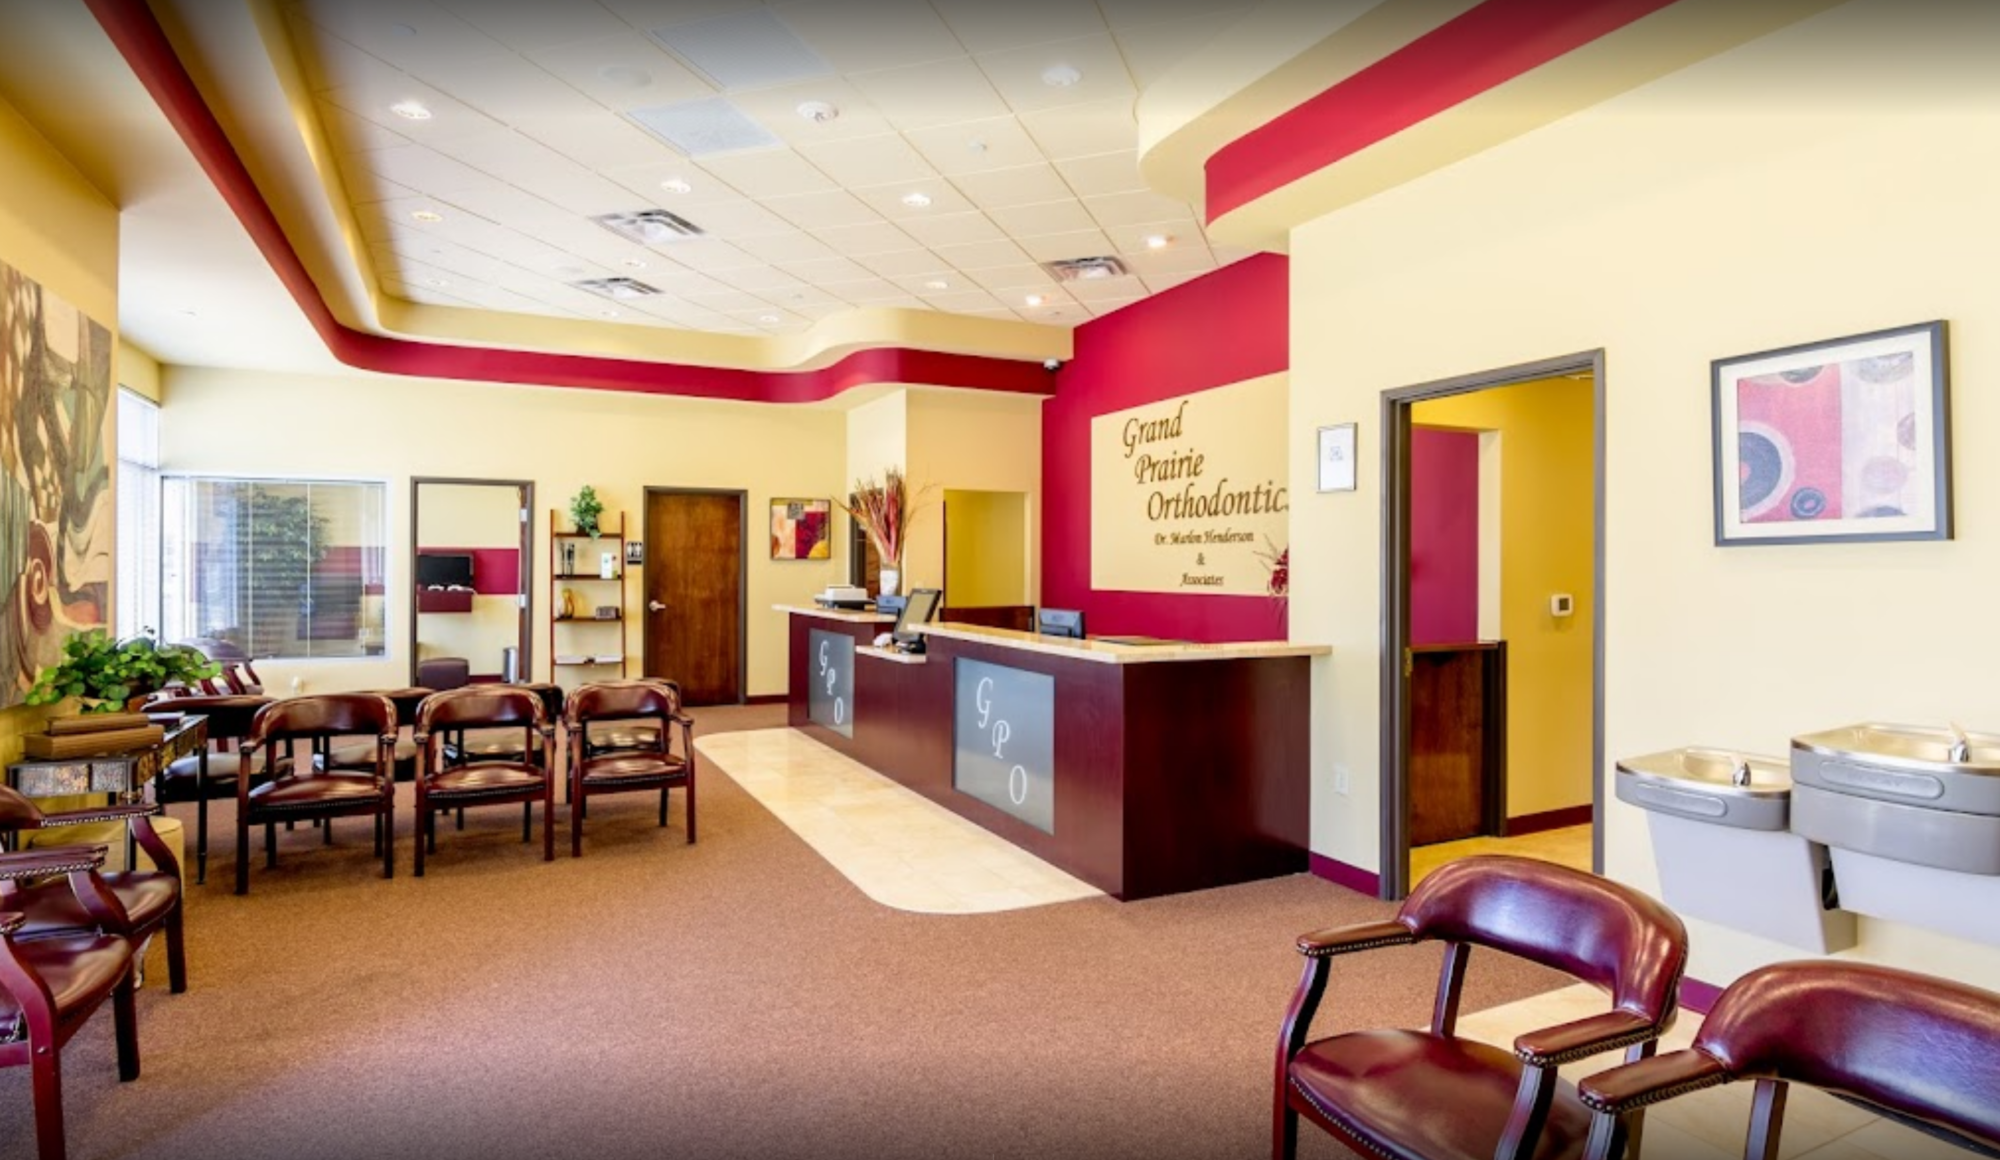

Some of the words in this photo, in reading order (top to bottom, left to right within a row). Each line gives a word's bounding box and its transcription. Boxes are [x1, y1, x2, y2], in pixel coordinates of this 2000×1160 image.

[1122, 400, 1189, 459] Grand
[1134, 448, 1205, 485] Prairie
[1147, 478, 1289, 522] Orthodontic
[1154, 532, 1169, 546] Dr.
[1203, 527, 1254, 544] Henderson
[1196, 552, 1205, 566] &
[1180, 572, 1224, 587] Associates
